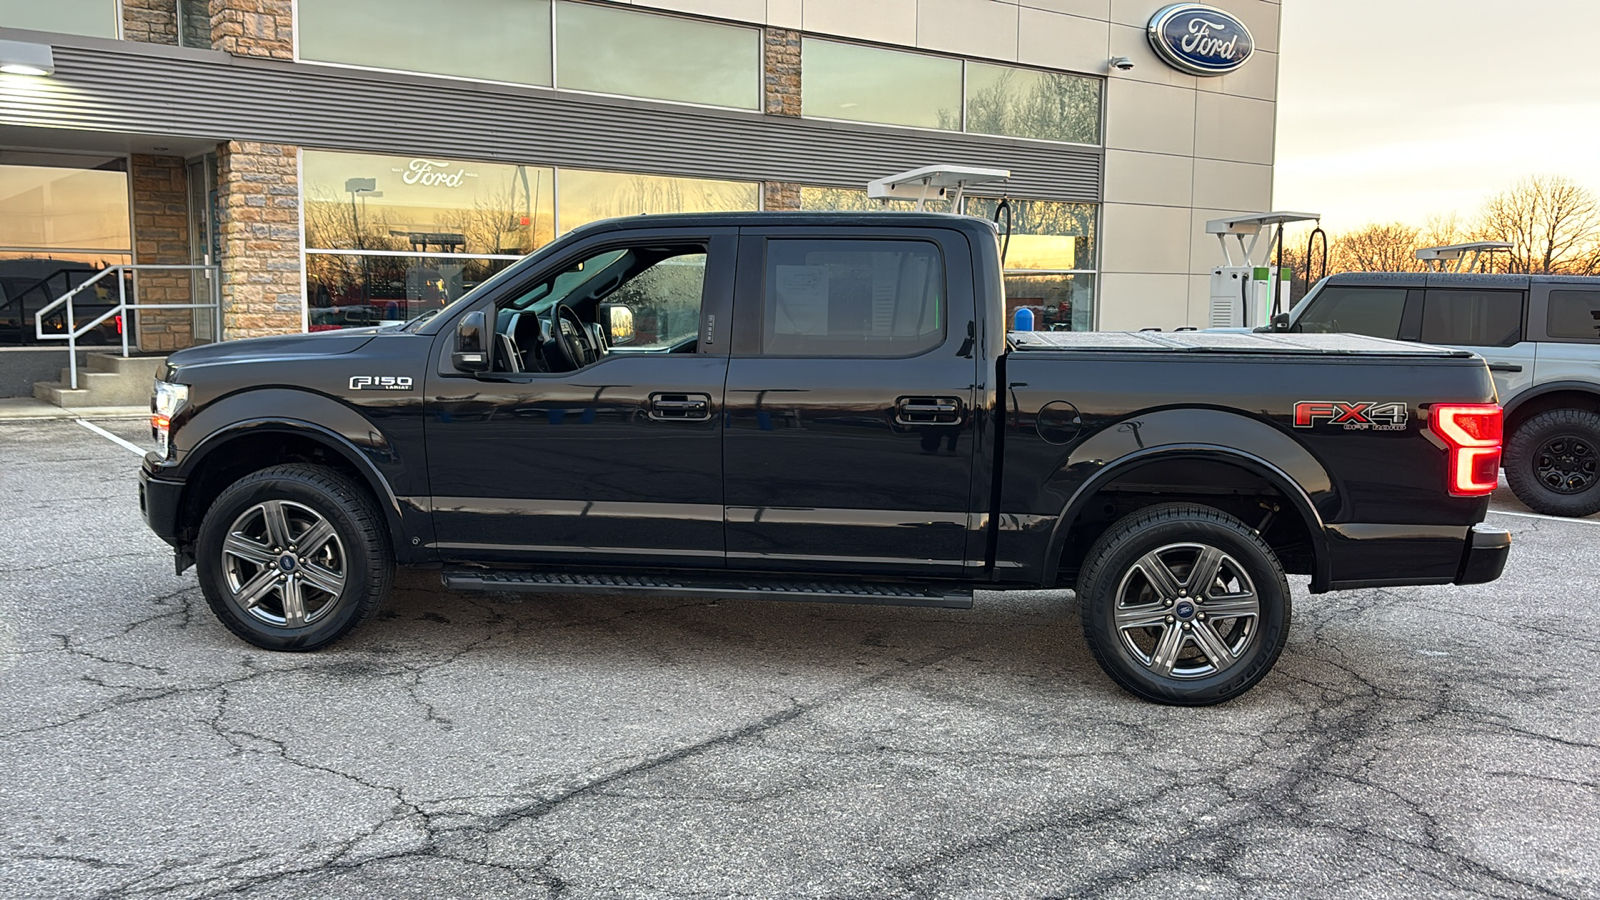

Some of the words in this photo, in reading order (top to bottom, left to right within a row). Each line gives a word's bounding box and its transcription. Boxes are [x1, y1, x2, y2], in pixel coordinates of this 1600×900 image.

[1181, 18, 1238, 60] Ford
[402, 158, 464, 187] Ford
[349, 376, 413, 389] F150
[1293, 401, 1407, 427] FX4
